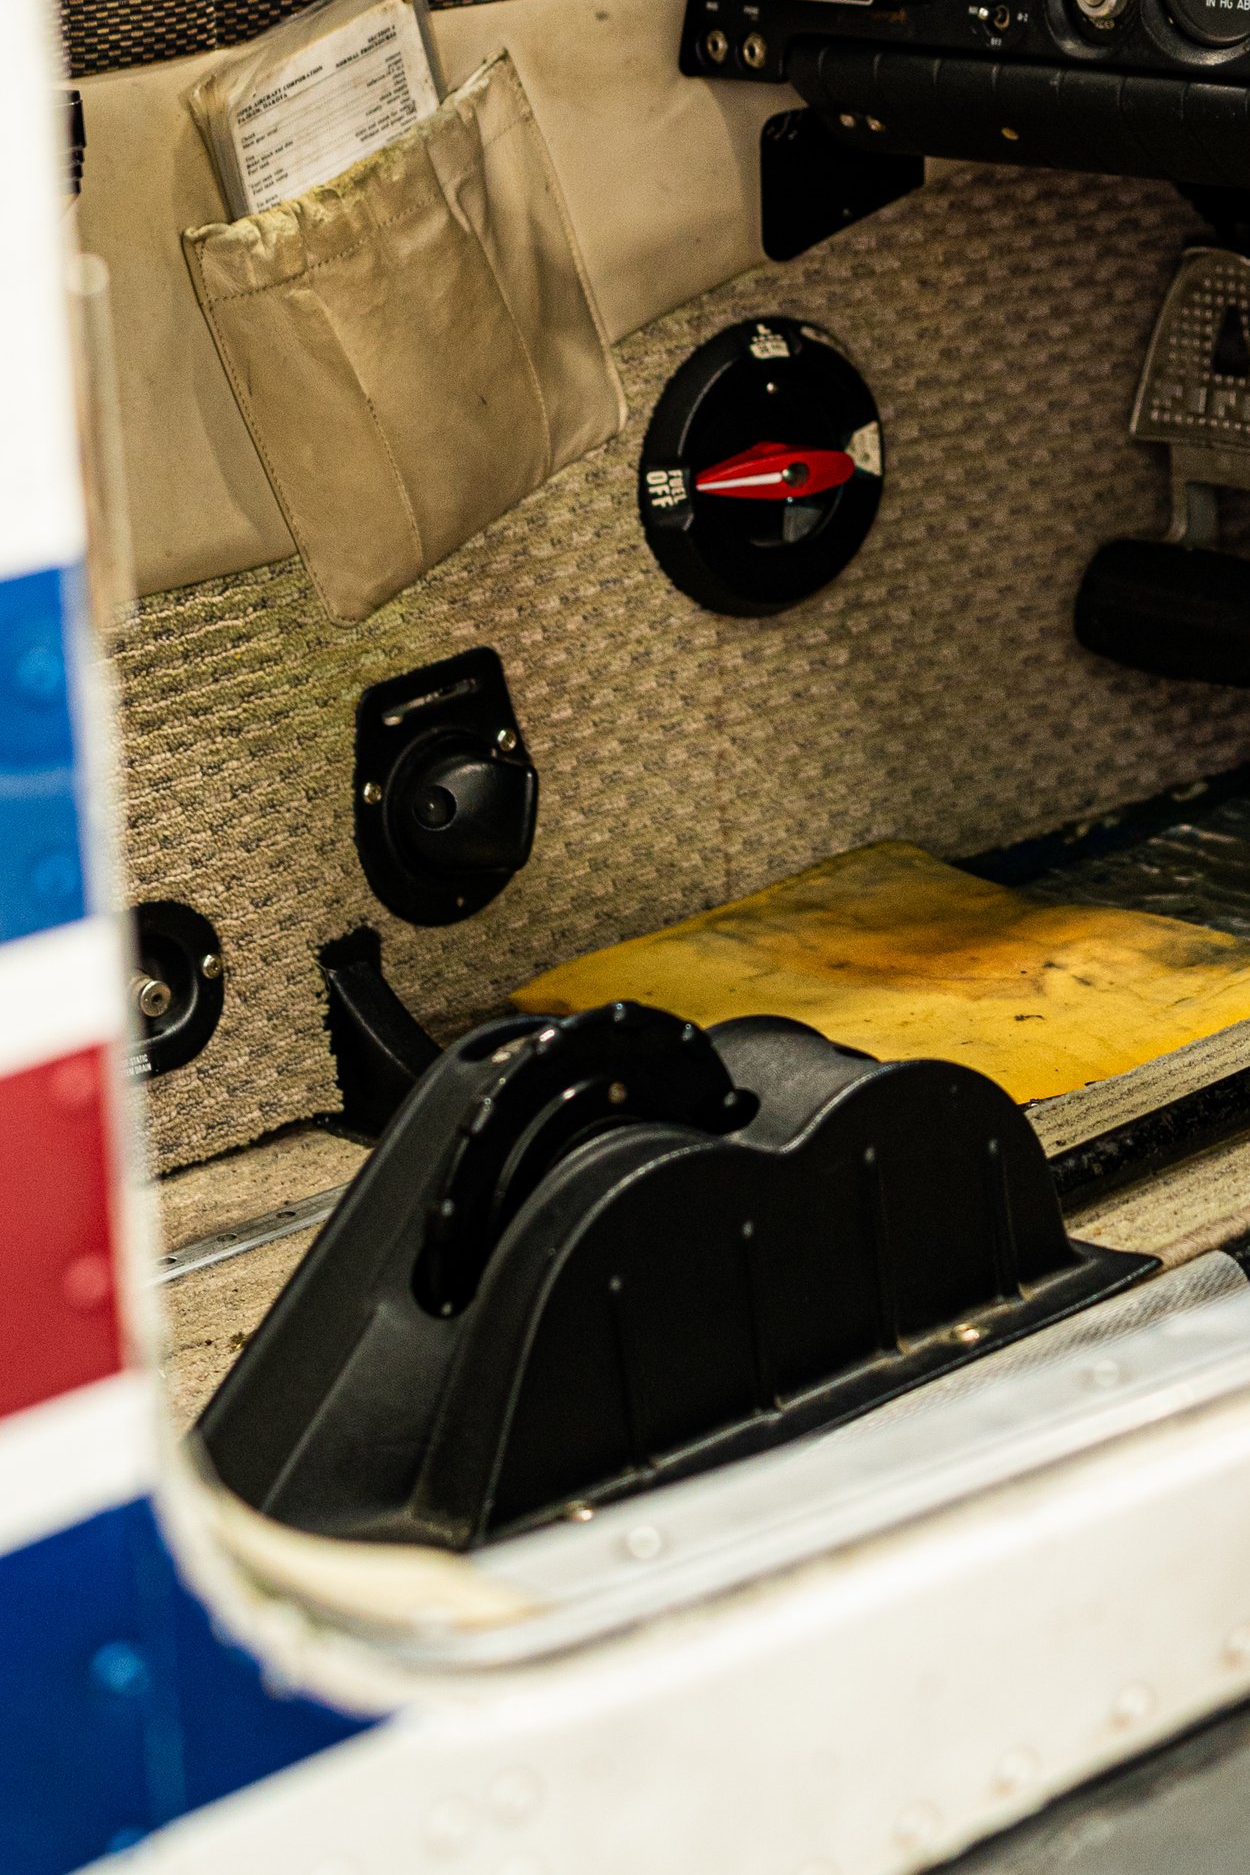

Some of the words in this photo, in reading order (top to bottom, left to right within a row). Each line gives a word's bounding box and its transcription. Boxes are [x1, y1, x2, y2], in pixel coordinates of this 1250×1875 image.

[1219, 0, 1233, 9] HG
[646, 469, 675, 509] OFF
[668, 469, 688, 505] FUEL
